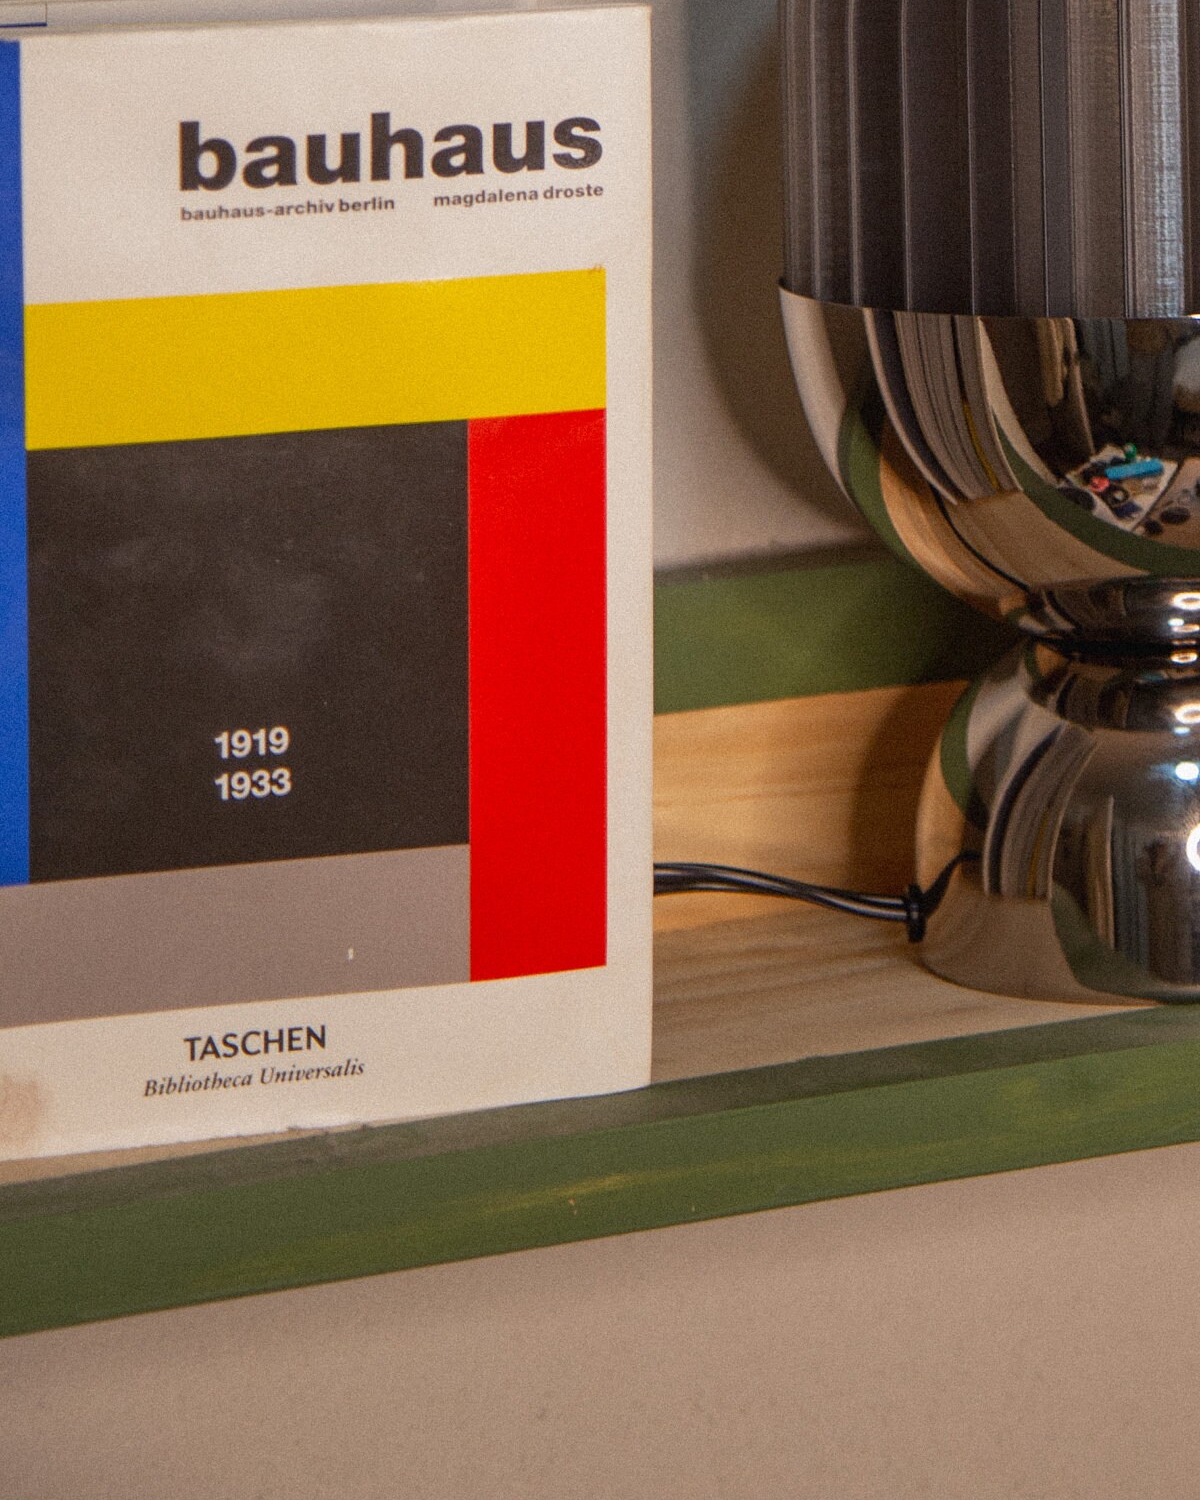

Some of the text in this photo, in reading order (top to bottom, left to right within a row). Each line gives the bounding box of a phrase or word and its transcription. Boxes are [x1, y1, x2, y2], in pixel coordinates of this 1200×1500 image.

[179, 111, 604, 192] bauhaus
[180, 196, 396, 222] bauhaus-archiv berlin
[433, 183, 605, 209] magdalena droste
[214, 726, 290, 759] 1919
[214, 767, 292, 800] 1933
[183, 1024, 327, 1062] TASCHEN
[143, 1058, 365, 1098] Bibliotheca Universalis
